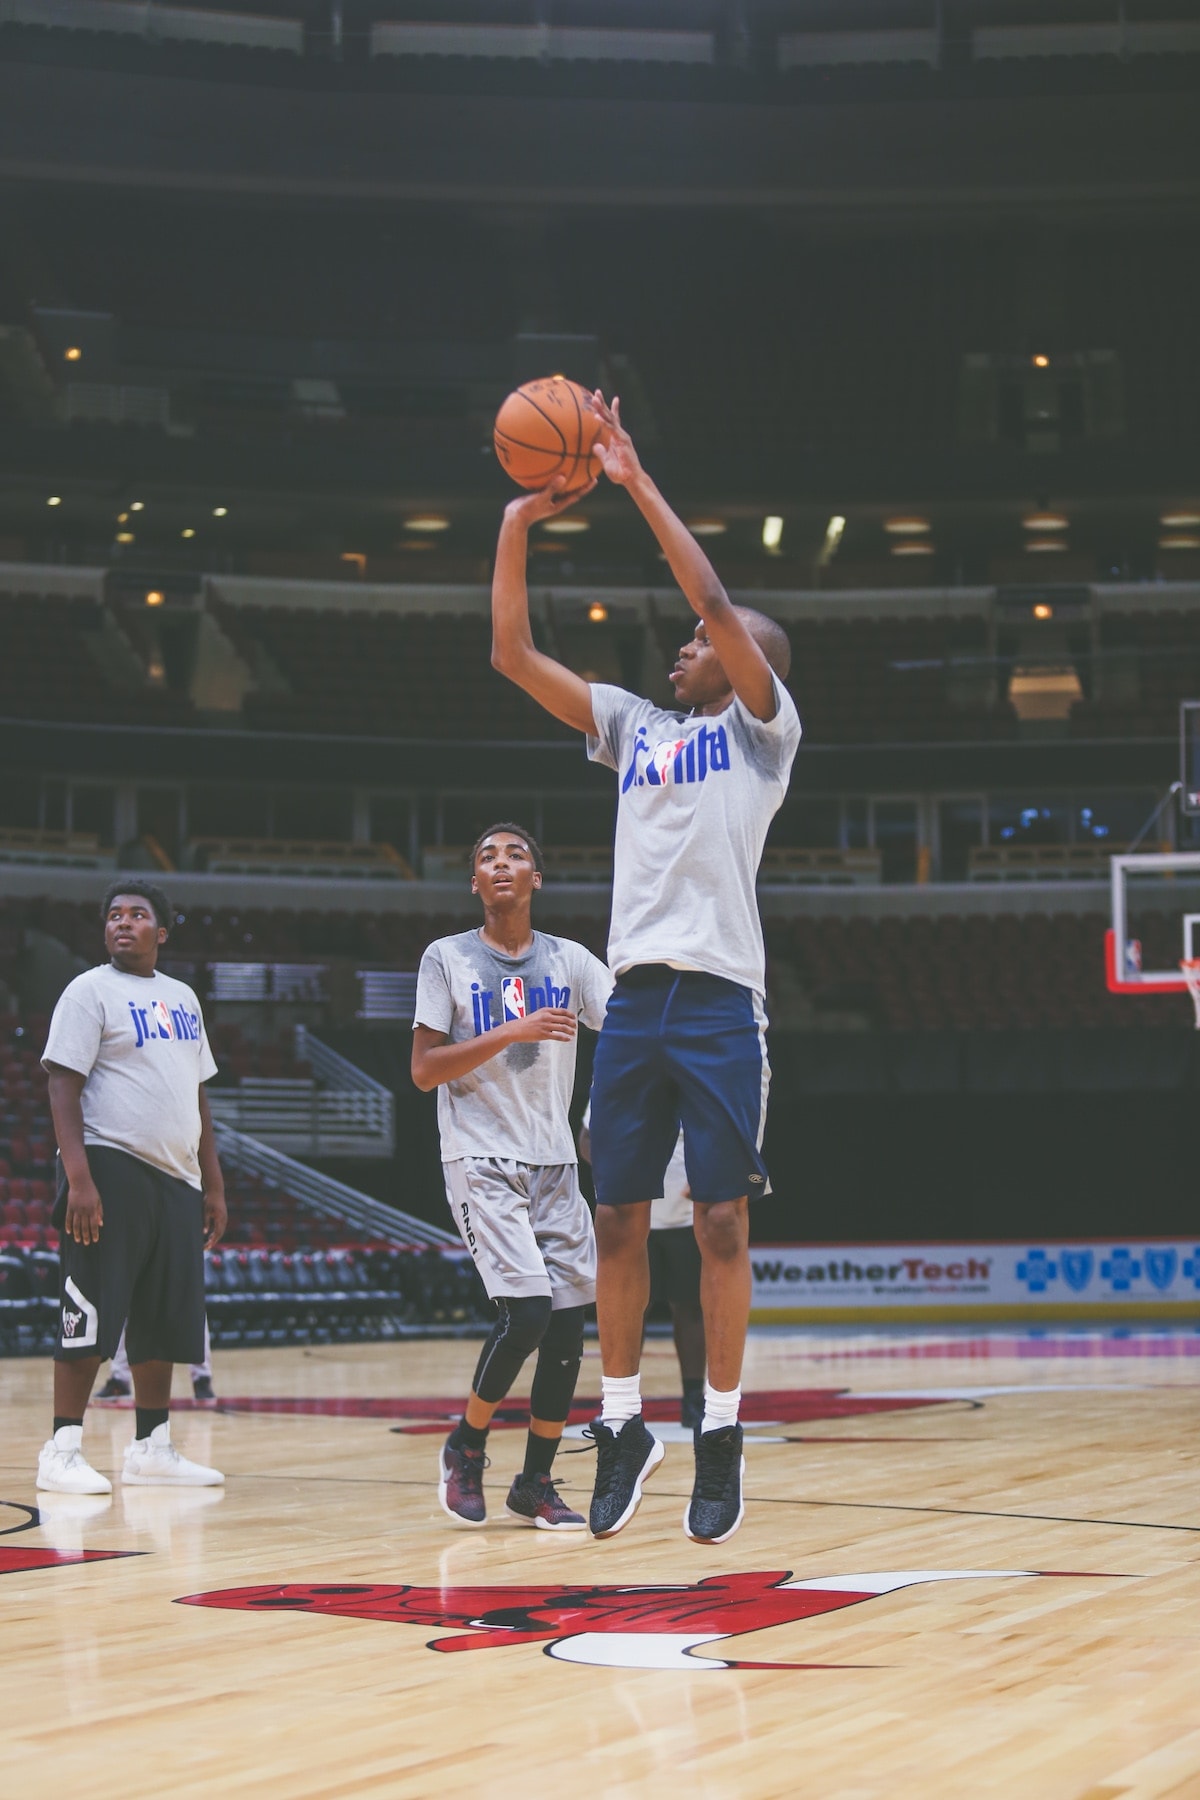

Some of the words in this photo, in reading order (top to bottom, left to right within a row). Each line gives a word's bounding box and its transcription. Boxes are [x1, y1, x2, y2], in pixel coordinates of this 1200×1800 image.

[622, 726, 650, 795] jr.
[674, 724, 731, 784] nba
[128, 1001, 157, 1048] jr.
[752, 1258, 990, 1283] WeatherTech
